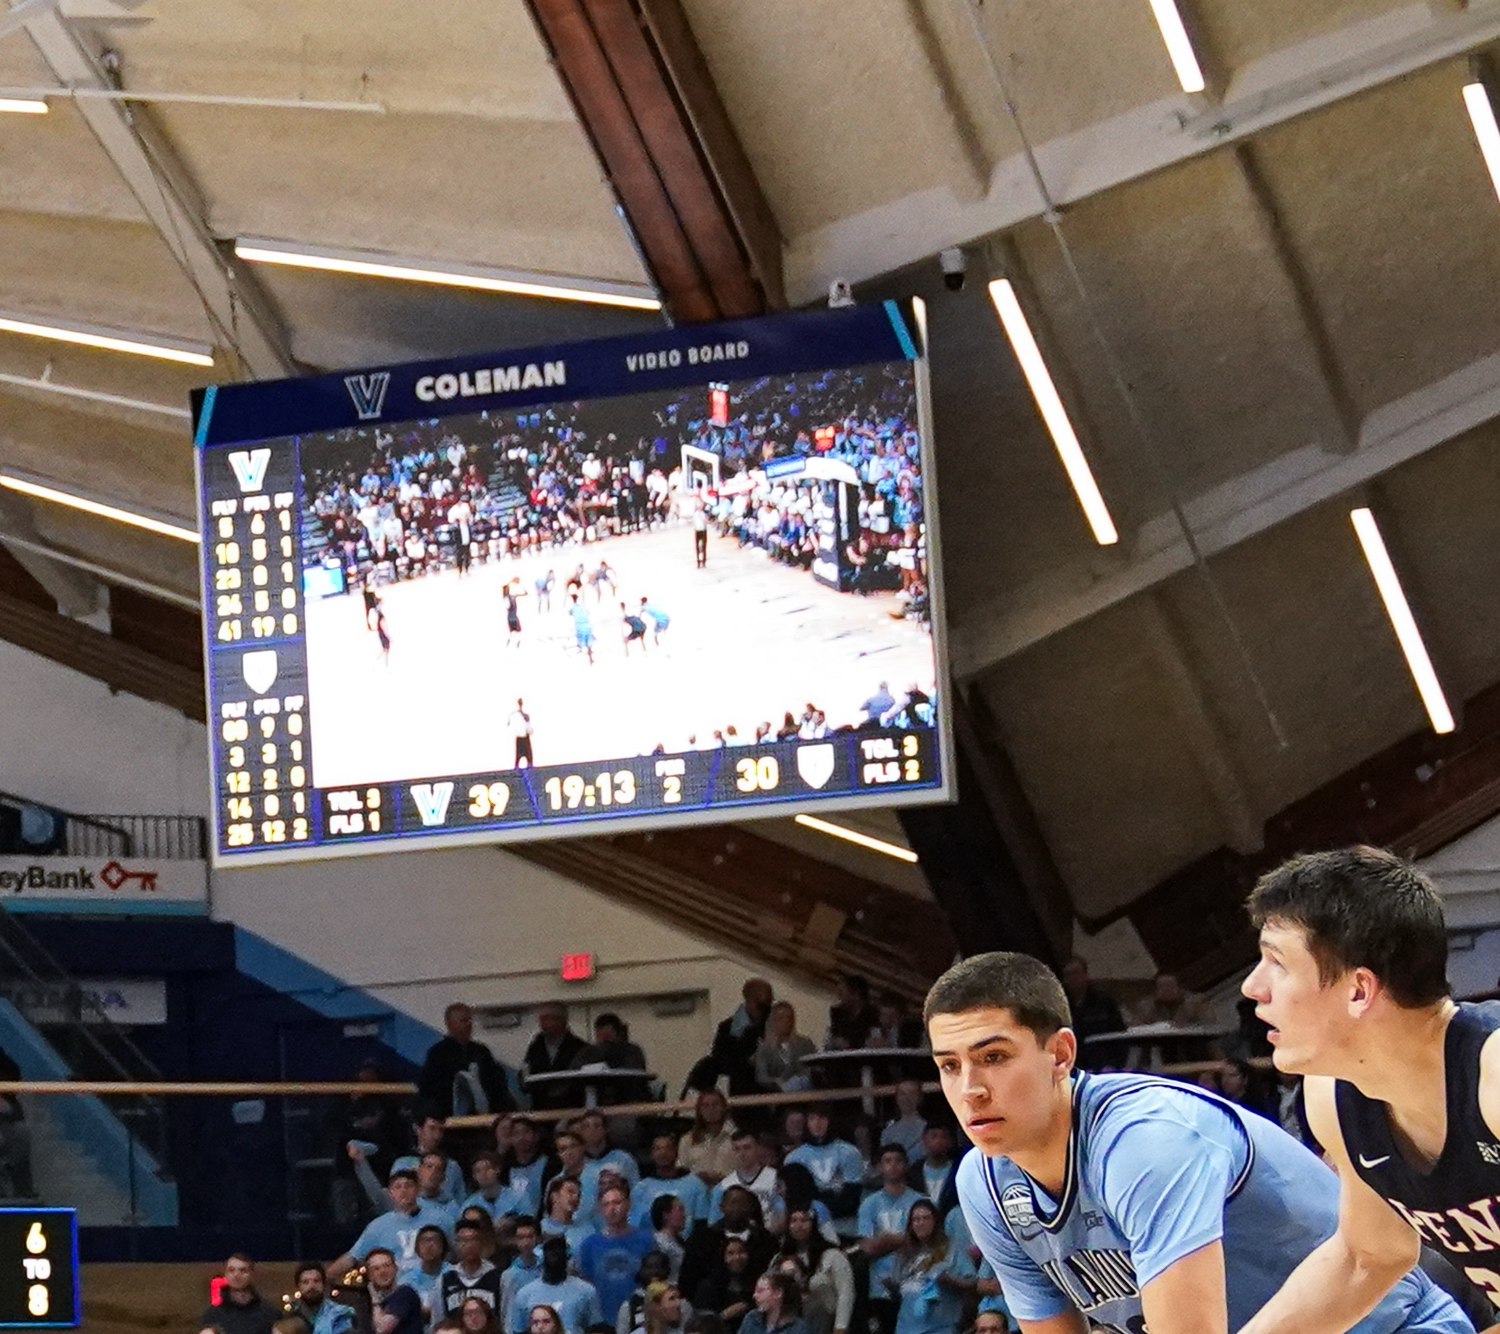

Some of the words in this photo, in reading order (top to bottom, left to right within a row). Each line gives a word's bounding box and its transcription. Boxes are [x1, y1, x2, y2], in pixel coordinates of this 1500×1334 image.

[415, 360, 567, 402] COLEMAN
[626, 348, 681, 372] VIDEO
[688, 341, 750, 365] BOARD
[861, 738, 898, 760] TOL
[903, 735, 918, 756] 3
[226, 771, 250, 794] 12
[263, 768, 278, 790] 2
[905, 759, 920, 781] 2
[545, 769, 636, 810] 19:13
[663, 776, 681, 805] 2
[736, 756, 779, 791] 30
[366, 788, 381, 809] 3
[469, 782, 510, 818] 39
[261, 820, 286, 842] 12
[293, 817, 308, 840] 2
[368, 811, 381, 832] 1
[26, 1222, 47, 1255] 6
[22, 1259, 51, 1280] TO
[28, 1284, 49, 1317] 8
